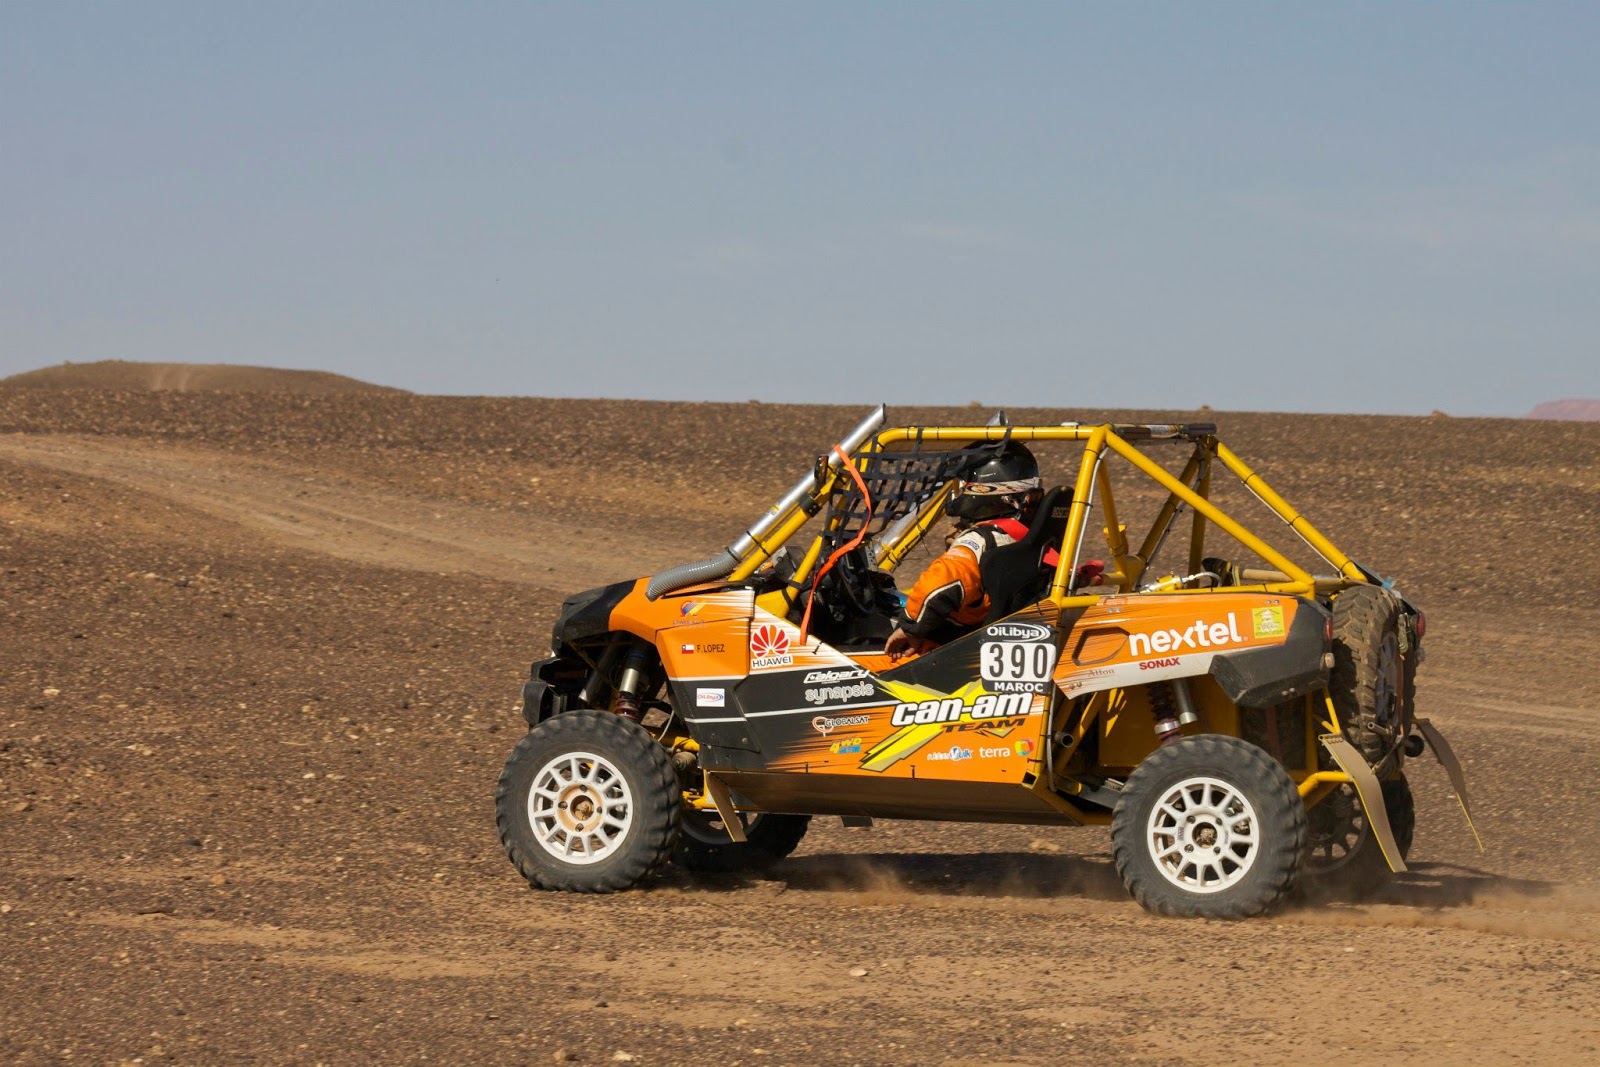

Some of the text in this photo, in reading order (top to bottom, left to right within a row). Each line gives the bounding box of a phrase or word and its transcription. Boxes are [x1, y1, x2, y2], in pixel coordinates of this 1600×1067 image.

[987, 626, 1040, 639] OiLibya
[1129, 612, 1242, 656] nextel
[752, 656, 792, 667] HUAWEI
[989, 643, 1048, 679] 390
[1139, 657, 1181, 670] SONAX
[803, 669, 870, 684] Calgary
[804, 680, 875, 705] synapsis
[994, 682, 1044, 692] MAROC
[891, 692, 1033, 727] can-am
[825, 715, 869, 728] GLOBALSAT
[942, 717, 1026, 733] TEAM
[979, 747, 1011, 758] terra
